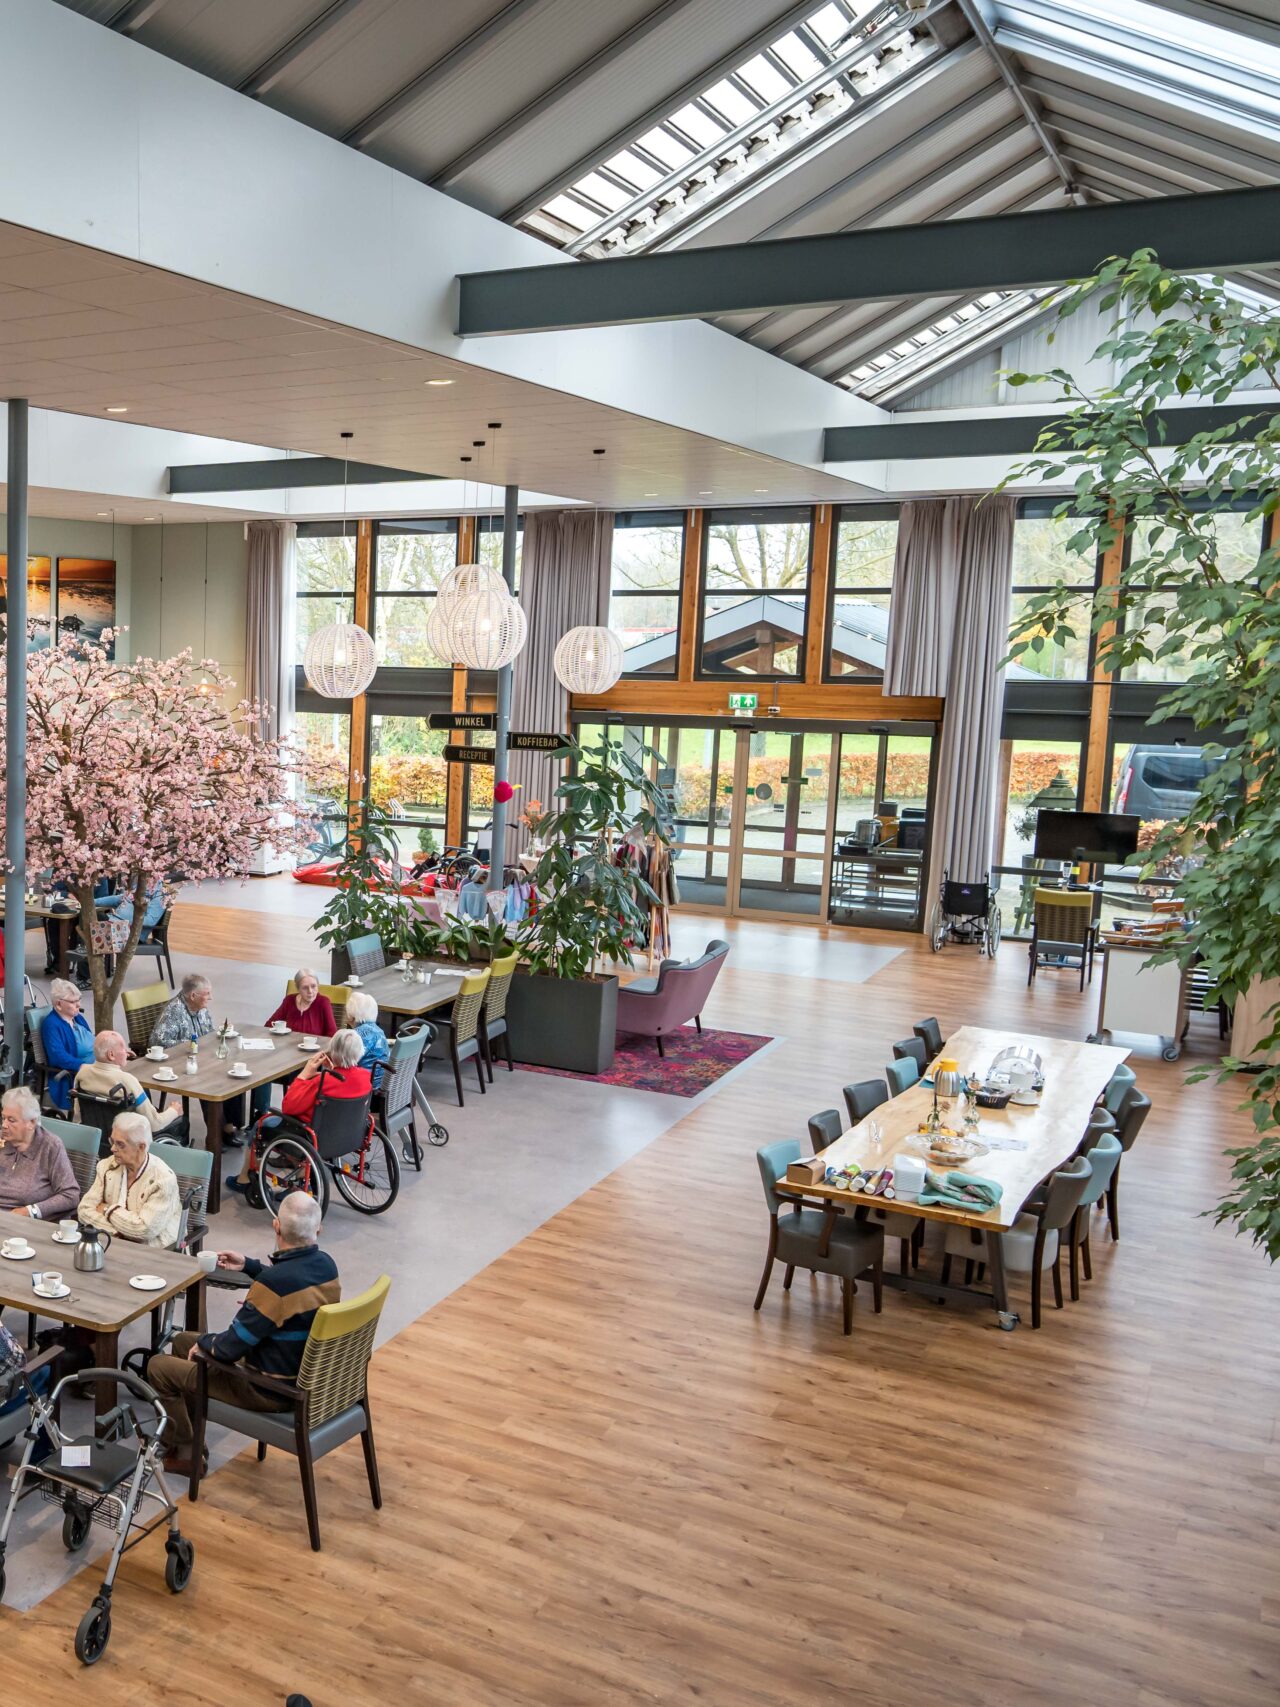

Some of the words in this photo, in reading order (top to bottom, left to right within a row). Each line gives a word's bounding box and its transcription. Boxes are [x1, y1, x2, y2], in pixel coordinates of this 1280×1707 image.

[455, 717, 485, 727] WINKEL
[517, 736, 558, 748] KOFFIEBAR
[458, 750, 488, 761] RECEPTIE
